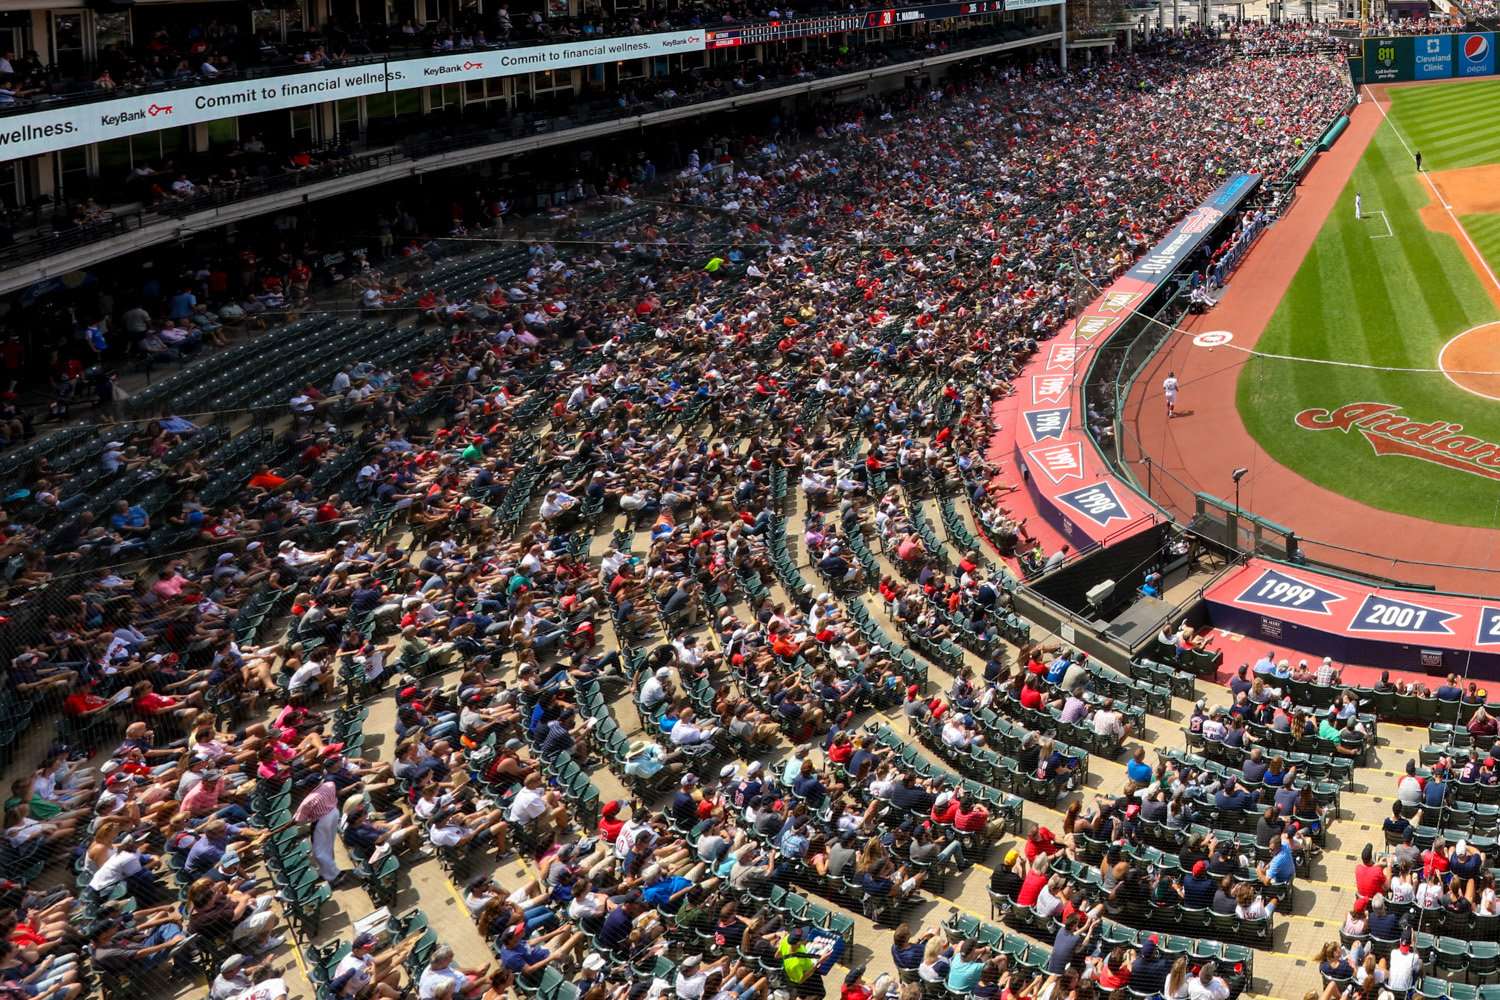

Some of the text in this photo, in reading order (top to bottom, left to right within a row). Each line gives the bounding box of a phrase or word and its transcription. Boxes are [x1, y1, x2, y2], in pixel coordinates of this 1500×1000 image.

[662, 36, 688, 47] KeyBank
[423, 41, 651, 77] KeyBank Commit to financial wellness.
[1378, 48, 1395, 60] 811
[1416, 53, 1451, 63] Cleveland
[1424, 64, 1444, 72] Clinic
[1466, 64, 1487, 73] pepsi
[101, 108, 147, 127] KeyBank
[195, 88, 257, 110] Commit
[261, 86, 277, 100] to
[281, 76, 342, 97] financial
[345, 71, 406, 88] wellness.
[1136, 255, 1175, 274] 1901
[1039, 377, 1061, 396] 1995
[1036, 411, 1060, 432] 1996
[1044, 448, 1077, 470] 1997
[1074, 488, 1117, 514] 1998
[1256, 578, 1316, 606] 1999
[1366, 604, 1427, 630] 2001
